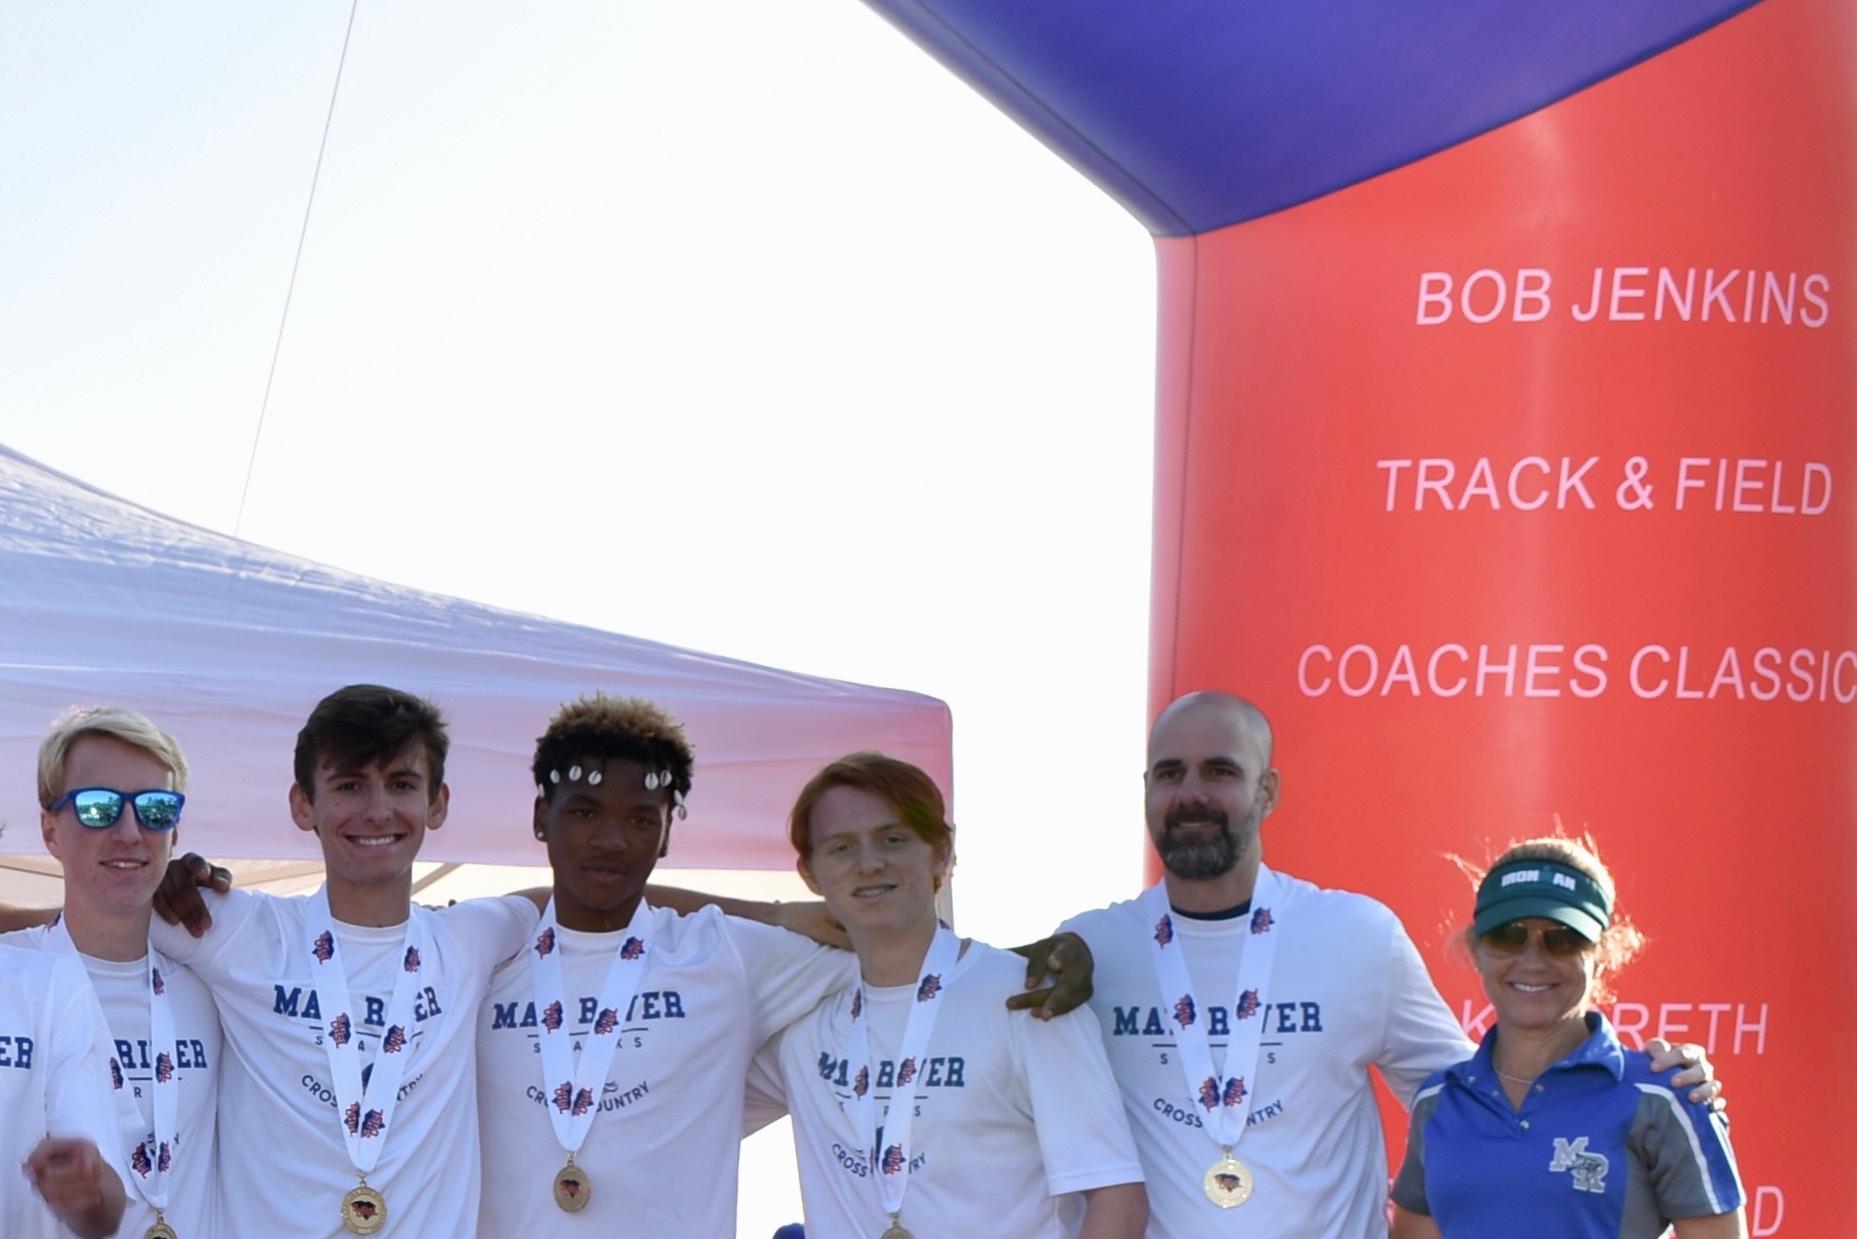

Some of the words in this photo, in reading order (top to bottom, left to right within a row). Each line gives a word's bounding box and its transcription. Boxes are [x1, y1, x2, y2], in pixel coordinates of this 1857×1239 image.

[1415, 267, 1553, 325] BOB
[1571, 266, 1831, 328] JENKINS
[1376, 456, 1600, 512] TRACK
[1615, 455, 1655, 511] &
[1674, 458, 1832, 516] FIELD
[1296, 644, 1608, 698] COACHES
[1629, 644, 1857, 704] CLASSIC
[273, 984, 323, 1020] MA
[492, 1001, 538, 1030] MA
[1113, 1006, 1170, 1036] MA
[1153, 1097, 1203, 1129] CROSS
[832, 1143, 868, 1177] CROSS
